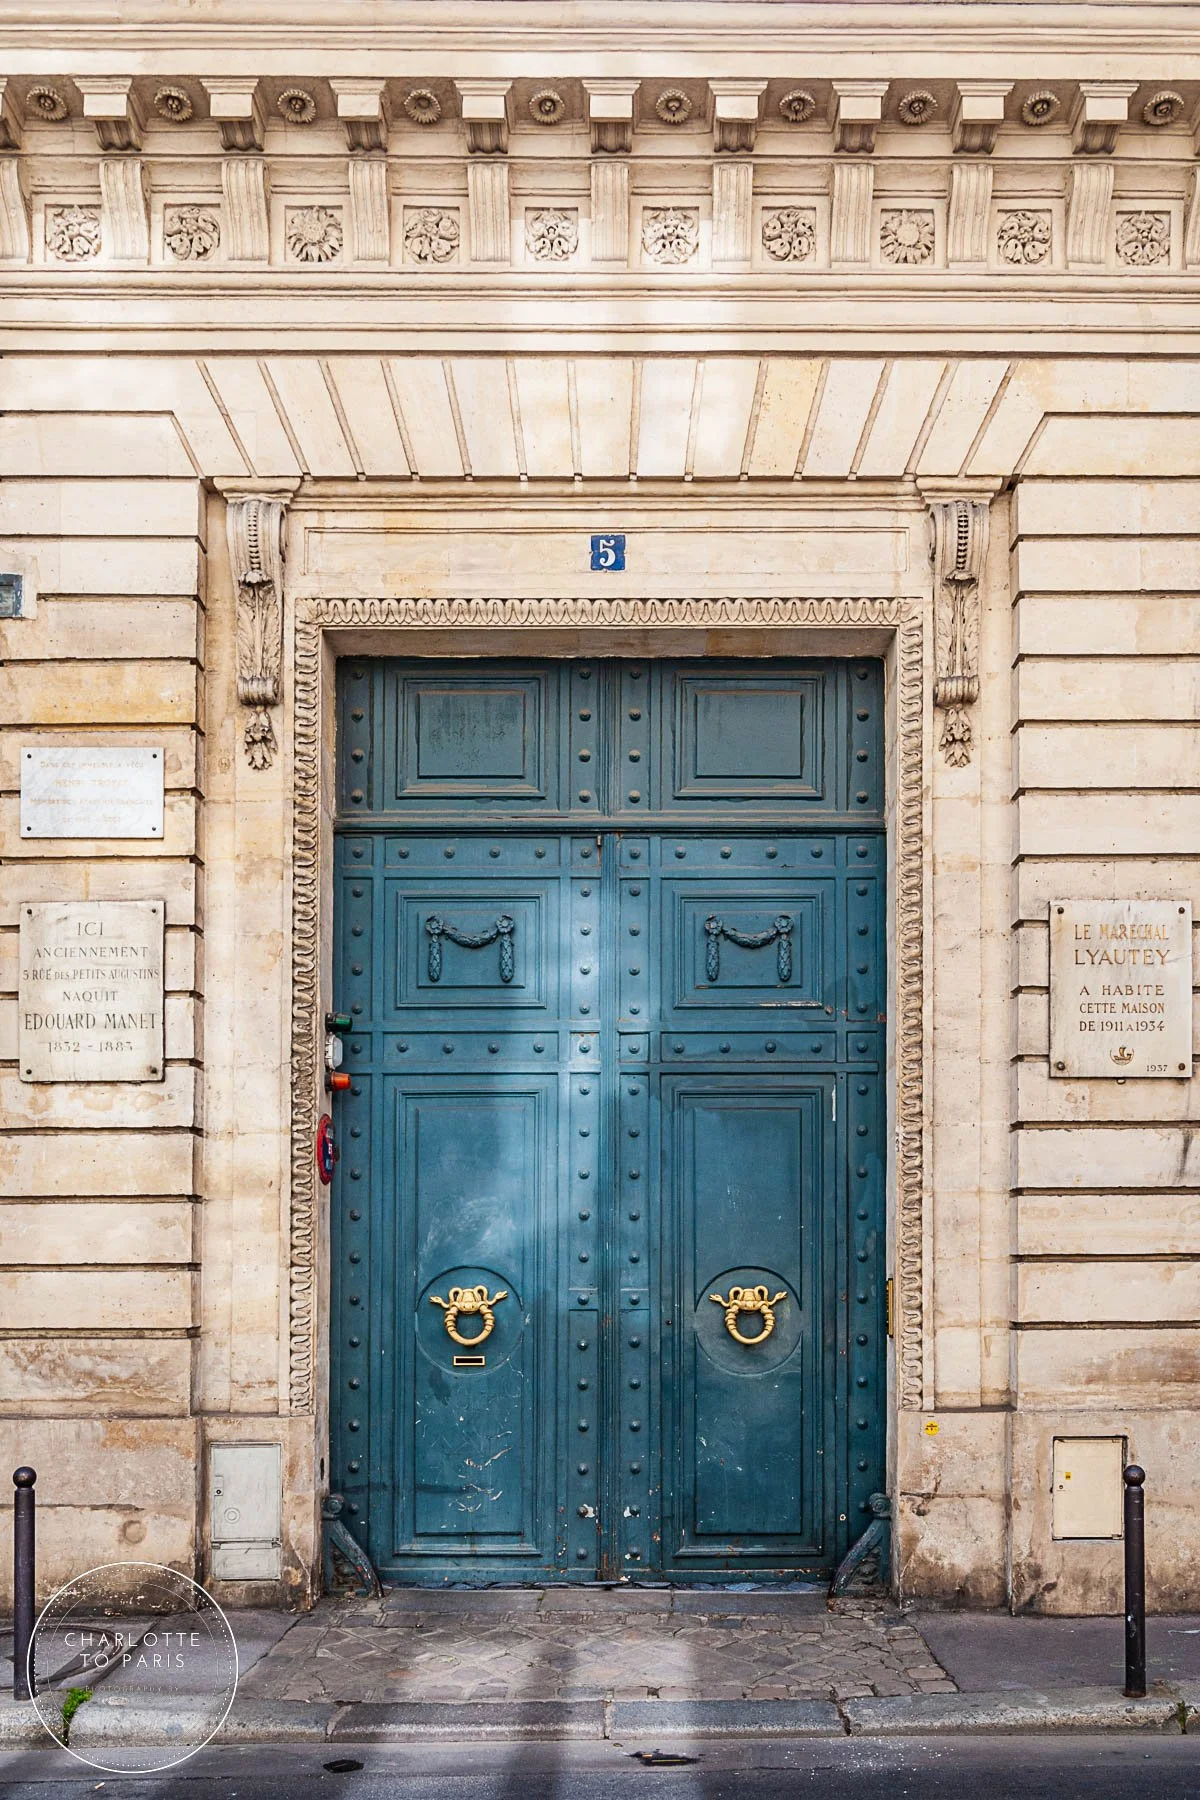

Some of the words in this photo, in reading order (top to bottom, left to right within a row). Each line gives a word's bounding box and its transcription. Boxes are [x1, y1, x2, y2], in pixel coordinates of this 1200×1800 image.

[599, 539, 616, 567] 5
[77, 921, 104, 936] ICI
[1074, 924, 1092, 940] LE
[1099, 923, 1169, 940] MARECHAL
[33, 946, 149, 959] ANCIENNEMENT
[1074, 949, 1170, 965] LYAUTEY
[23, 969, 30, 981] 5
[32, 968, 51, 981] RUE
[54, 971, 70, 980] DES
[72, 968, 106, 980] PETITS
[108, 968, 160, 980] AUGUSTINS
[1079, 985, 1090, 996] A
[1102, 984, 1165, 996] HABITE
[62, 991, 119, 1003] NAQUIT
[1079, 1002, 1117, 1014] CETTE
[1121, 1002, 1165, 1014] MAISON
[24, 1013, 97, 1030] EDOUARD
[103, 1013, 158, 1029] MANET
[1079, 1021, 1096, 1032] DE
[1100, 1021, 1124, 1032] 1911
[1126, 1024, 1134, 1032] A
[1135, 1020, 1166, 1032] 1934
[48, 1041, 81, 1053] 1832
[99, 1041, 133, 1053] 1883
[1146, 1064, 1168, 1072] 1937
